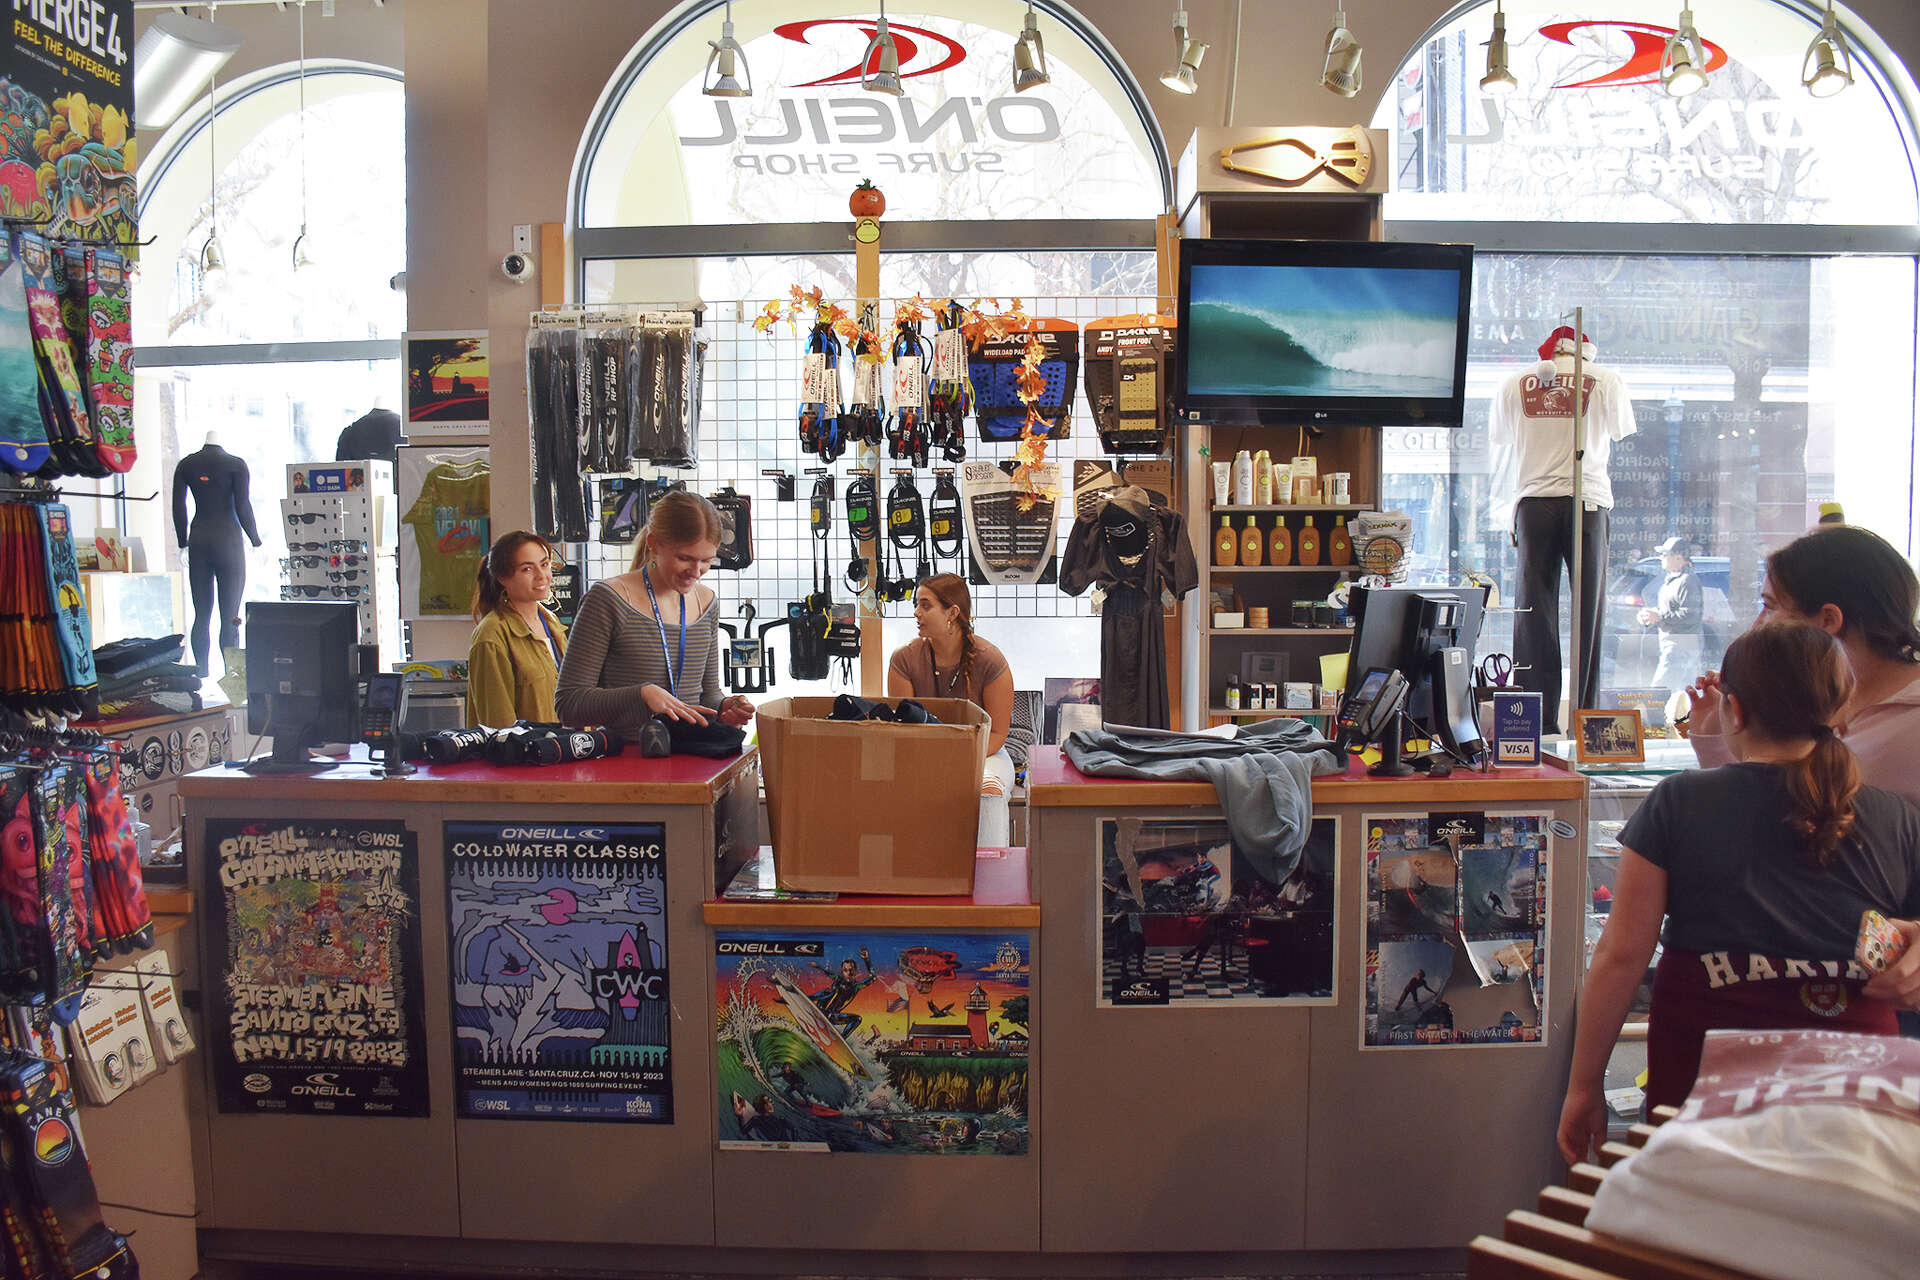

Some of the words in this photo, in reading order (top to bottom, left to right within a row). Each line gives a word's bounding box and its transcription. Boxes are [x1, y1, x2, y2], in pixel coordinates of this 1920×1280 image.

[14, 20, 42, 45] FEEL
[43, 34, 64, 56] THE
[65, 46, 121, 86] DIFFERENCE
[1116, 328, 1160, 336] DAKINE
[1505, 744, 1530, 754] VISA
[502, 828, 576, 840] O'NEILL
[1437, 827, 1476, 835] O'NEILL
[219, 826, 309, 861] O'NEILL
[373, 833, 403, 847] WSL
[573, 844, 660, 859] CLASSIC
[719, 943, 785, 954] O'NEILL
[1701, 951, 1869, 989] HARVA
[596, 970, 662, 999] CWC
[1120, 989, 1161, 997] O'NEILL
[230, 1006, 311, 1038] SANTA
[1389, 1031, 1414, 1041] FIRST
[295, 1038, 346, 1063] 15-19
[350, 1041, 407, 1067] 2022
[463, 1068, 501, 1076] STEAMER
[502, 1069, 524, 1077] LANE
[528, 1070, 556, 1078] SANTA
[599, 1071, 618, 1079] NOV
[643, 1073, 664, 1081] 2023
[291, 1085, 356, 1097] O'NEILL
[487, 1100, 511, 1111] WSL
[627, 1100, 651, 1109] KONA
